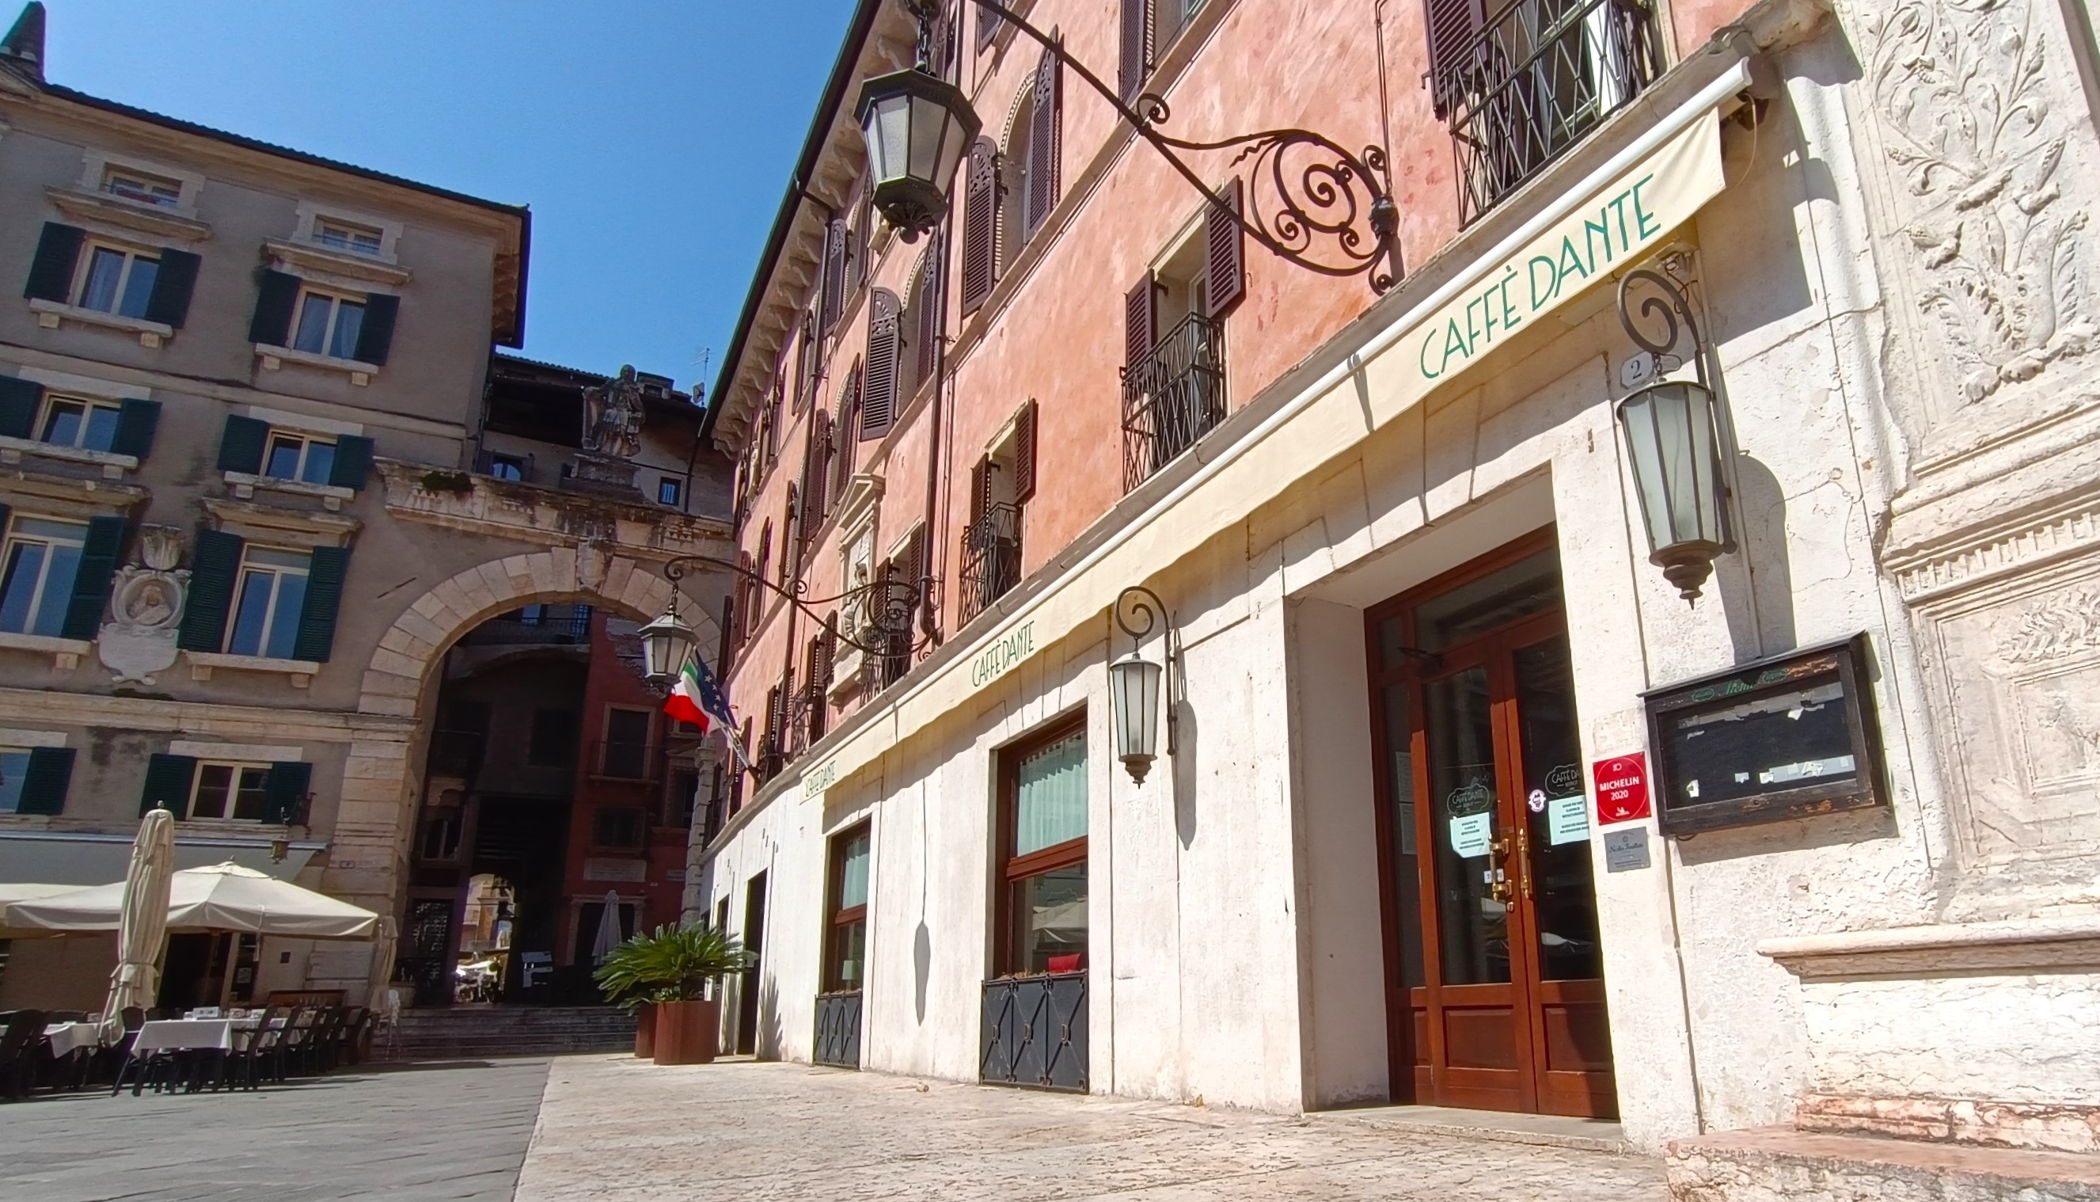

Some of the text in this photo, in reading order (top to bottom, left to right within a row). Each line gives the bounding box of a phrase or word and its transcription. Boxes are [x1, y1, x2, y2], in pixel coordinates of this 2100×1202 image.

[1420, 173, 1661, 379] CAFFÈ DANTE
[1630, 359, 1642, 380] 2
[972, 619, 1035, 687] CAFFÈ DANTE
[1599, 775, 1640, 792] MICHELIN
[1610, 789, 1629, 801] 2020
